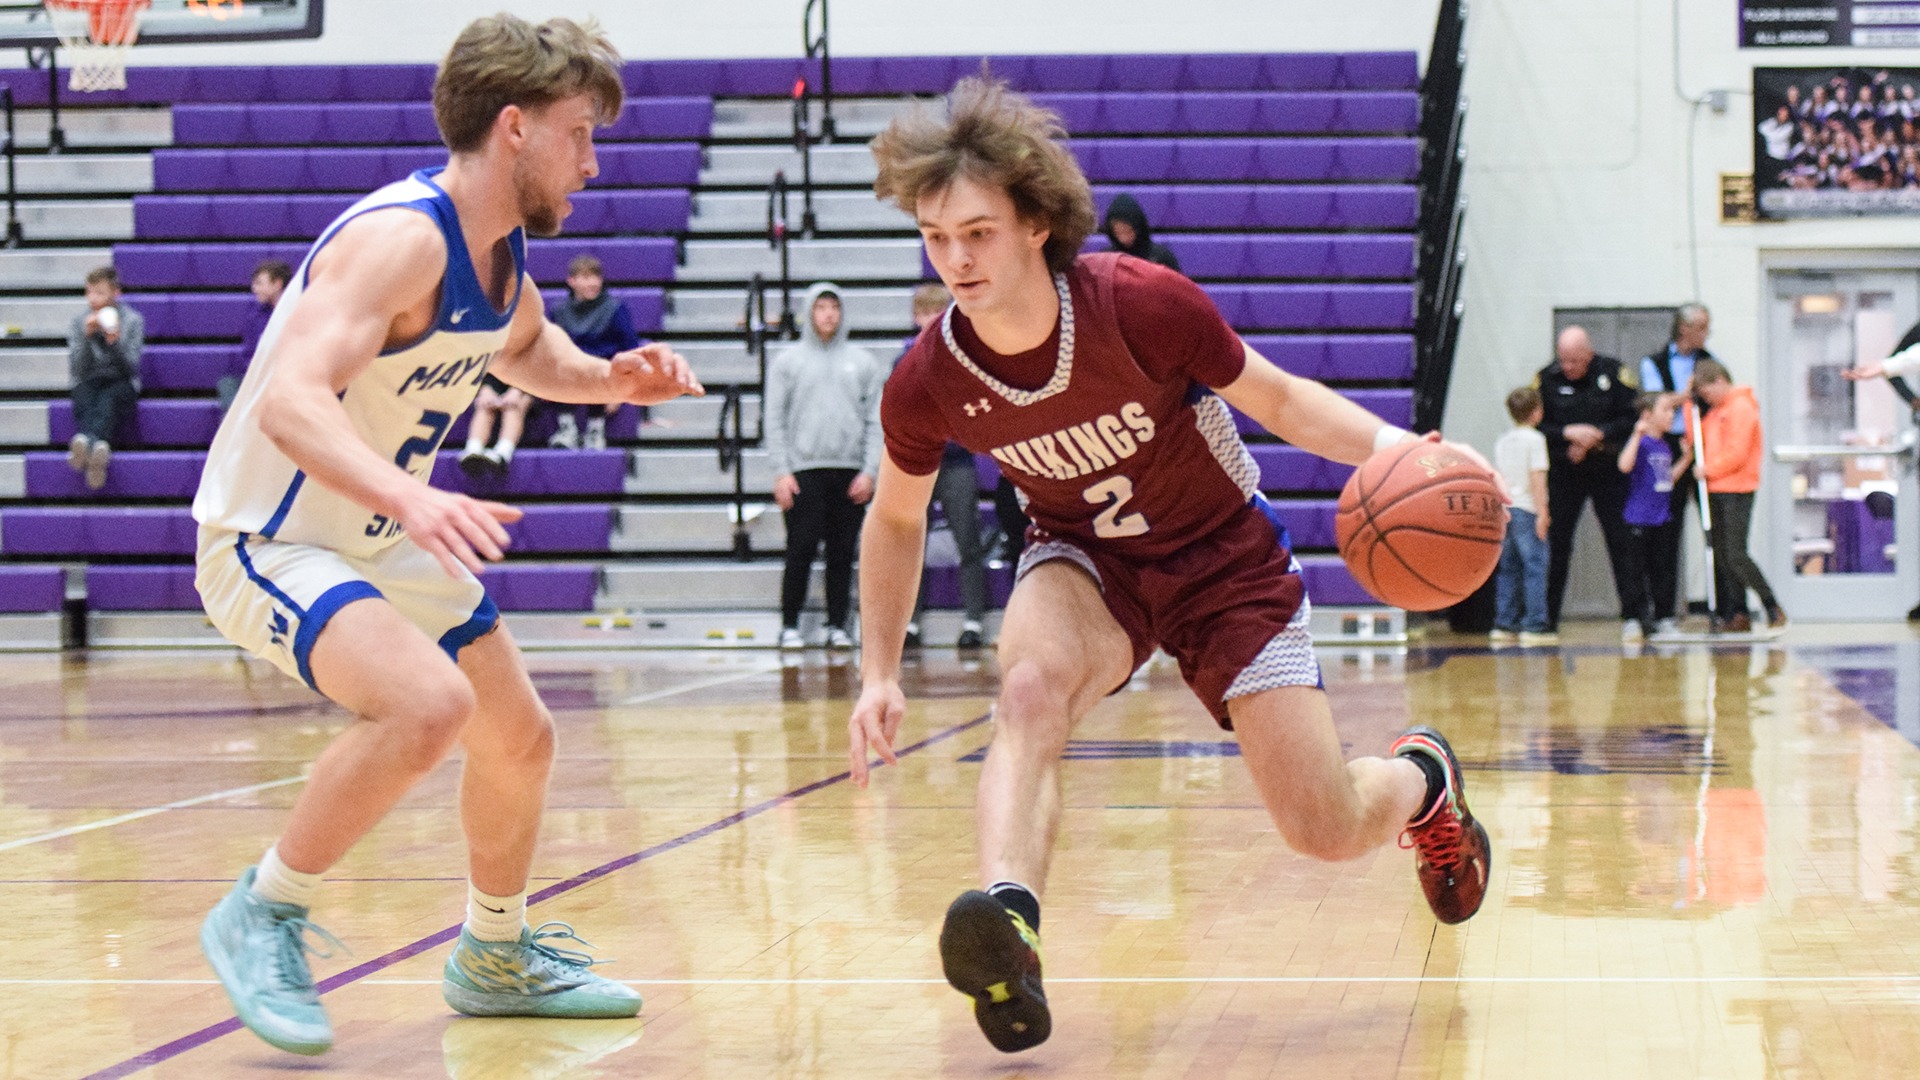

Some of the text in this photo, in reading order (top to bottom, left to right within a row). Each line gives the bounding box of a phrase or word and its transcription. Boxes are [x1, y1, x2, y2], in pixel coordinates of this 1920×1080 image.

[395, 409, 451, 475] 2
[991, 402, 1155, 480] VIKINGS
[1082, 475, 1150, 538] 2
